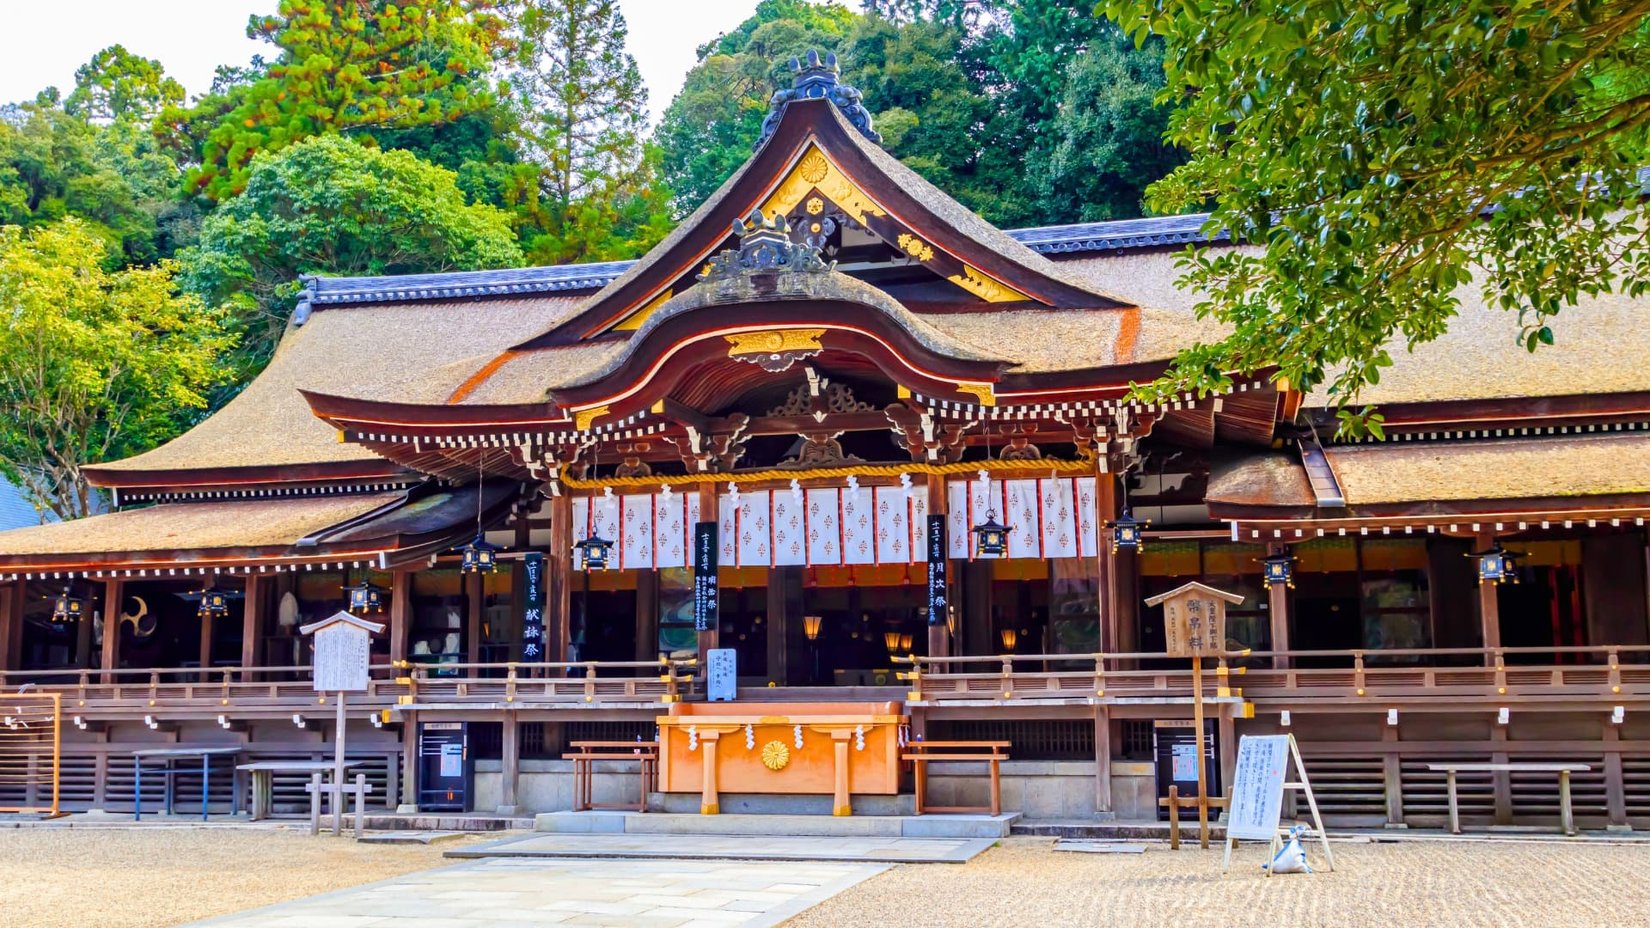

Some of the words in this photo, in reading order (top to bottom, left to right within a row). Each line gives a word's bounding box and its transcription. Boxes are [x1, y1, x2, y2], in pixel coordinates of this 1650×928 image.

[934, 562, 946, 607] 月次祭
[524, 608, 540, 656] 献詠祭
